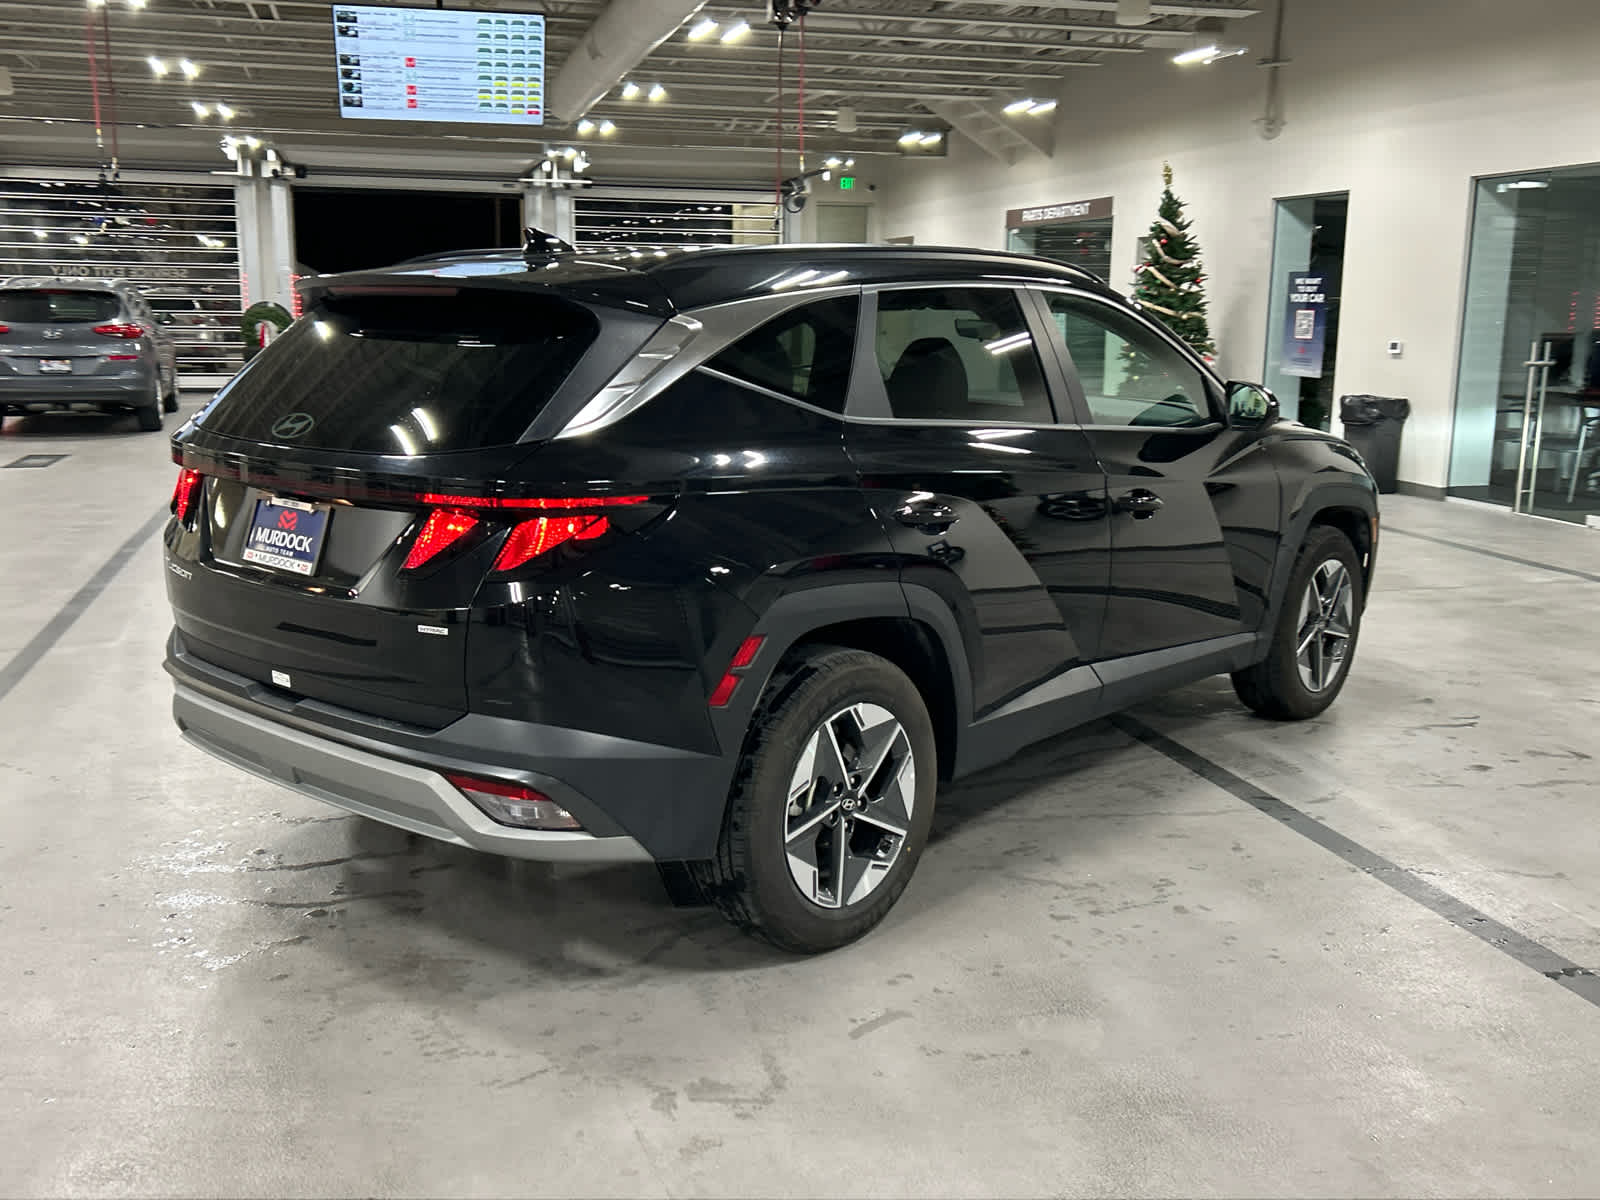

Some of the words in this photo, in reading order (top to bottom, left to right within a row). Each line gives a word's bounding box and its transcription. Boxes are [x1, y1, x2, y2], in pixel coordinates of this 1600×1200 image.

[1022, 208, 1042, 221] PARTS
[1043, 203, 1090, 219] DEPARTMENT
[1290, 293, 1309, 303] YOUR
[1310, 293, 1325, 303] CAR
[256, 527, 312, 552] MURDOCK
[266, 546, 279, 554] AUTO
[259, 553, 296, 569] MURDOCK
